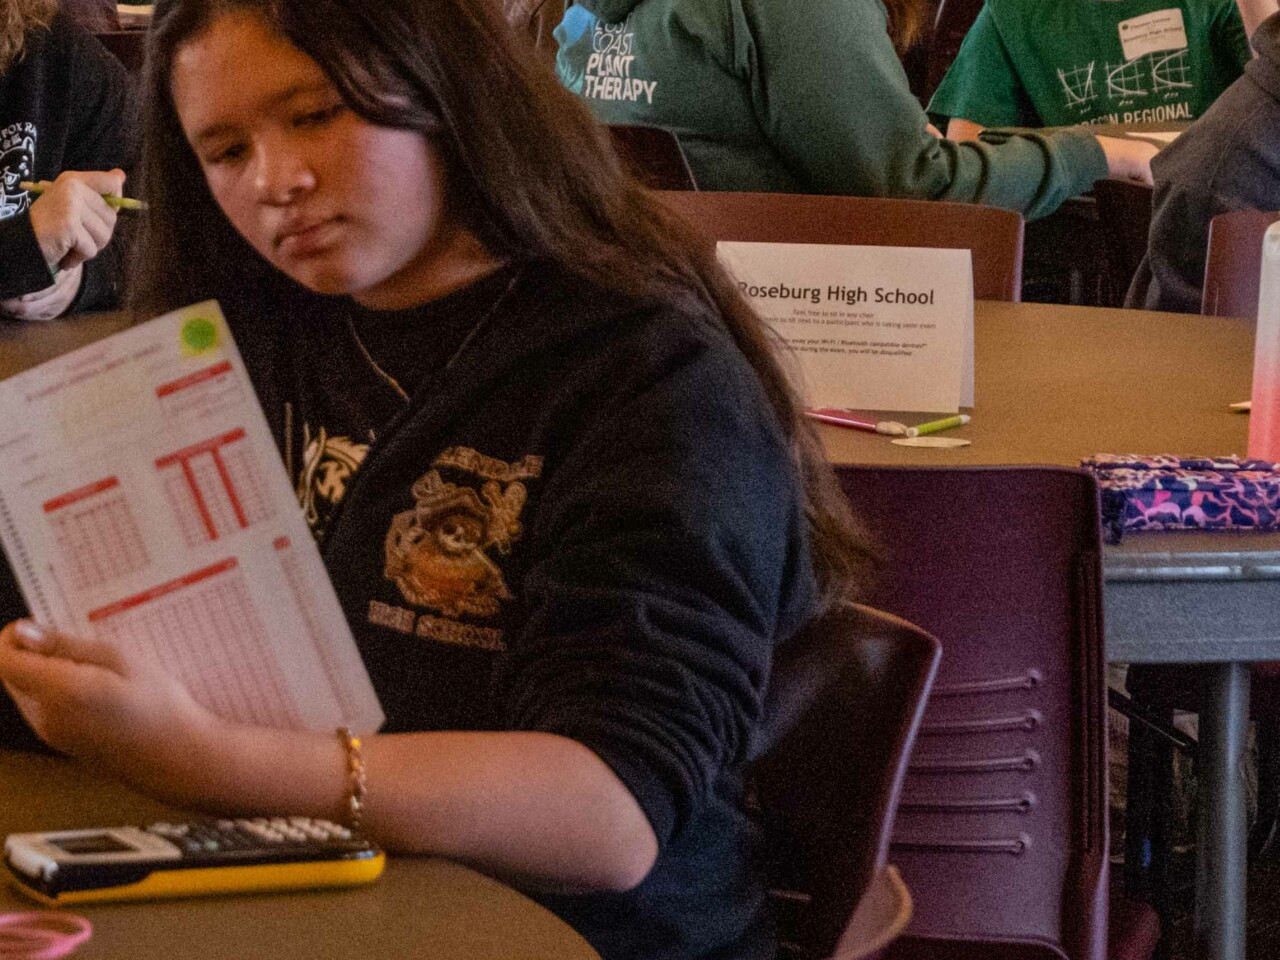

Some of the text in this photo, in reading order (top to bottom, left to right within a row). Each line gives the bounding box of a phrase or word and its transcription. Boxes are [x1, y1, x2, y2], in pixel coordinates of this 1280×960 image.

[592, 31, 634, 56] COAST
[587, 53, 634, 77] PLANT
[585, 75, 658, 104] THERAPY
[1124, 102, 1193, 124] REGIONAL
[1, 122, 23, 139] FOX
[738, 281, 934, 305] Roseburg High School
